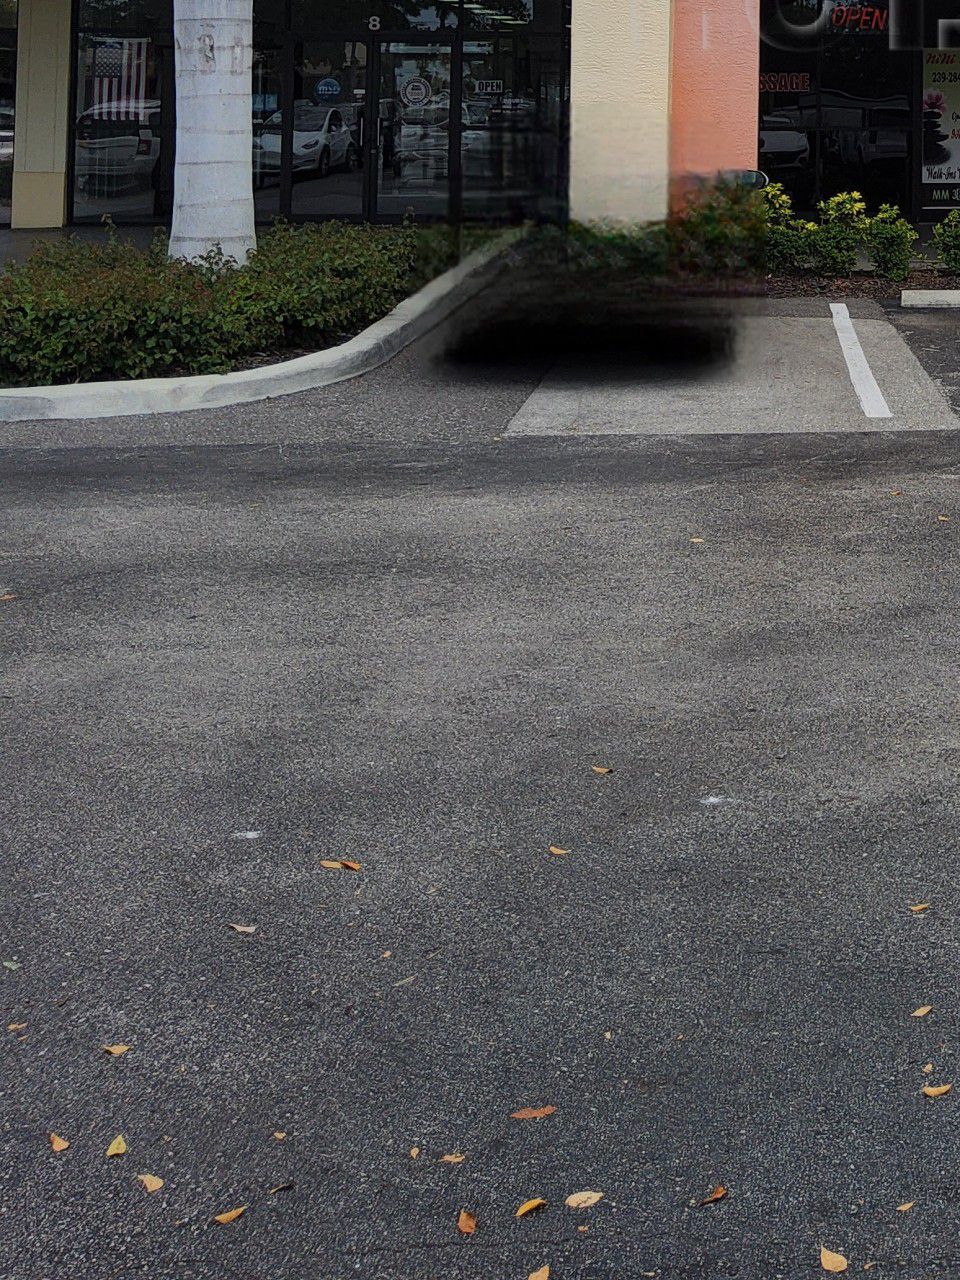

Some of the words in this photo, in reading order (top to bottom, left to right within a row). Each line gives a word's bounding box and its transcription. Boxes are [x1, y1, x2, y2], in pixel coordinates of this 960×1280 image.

[368, 16, 380, 30] 8
[832, 6, 887, 30] OPEN
[478, 81, 502, 93] OPEN
[932, 189, 950, 200] MM
